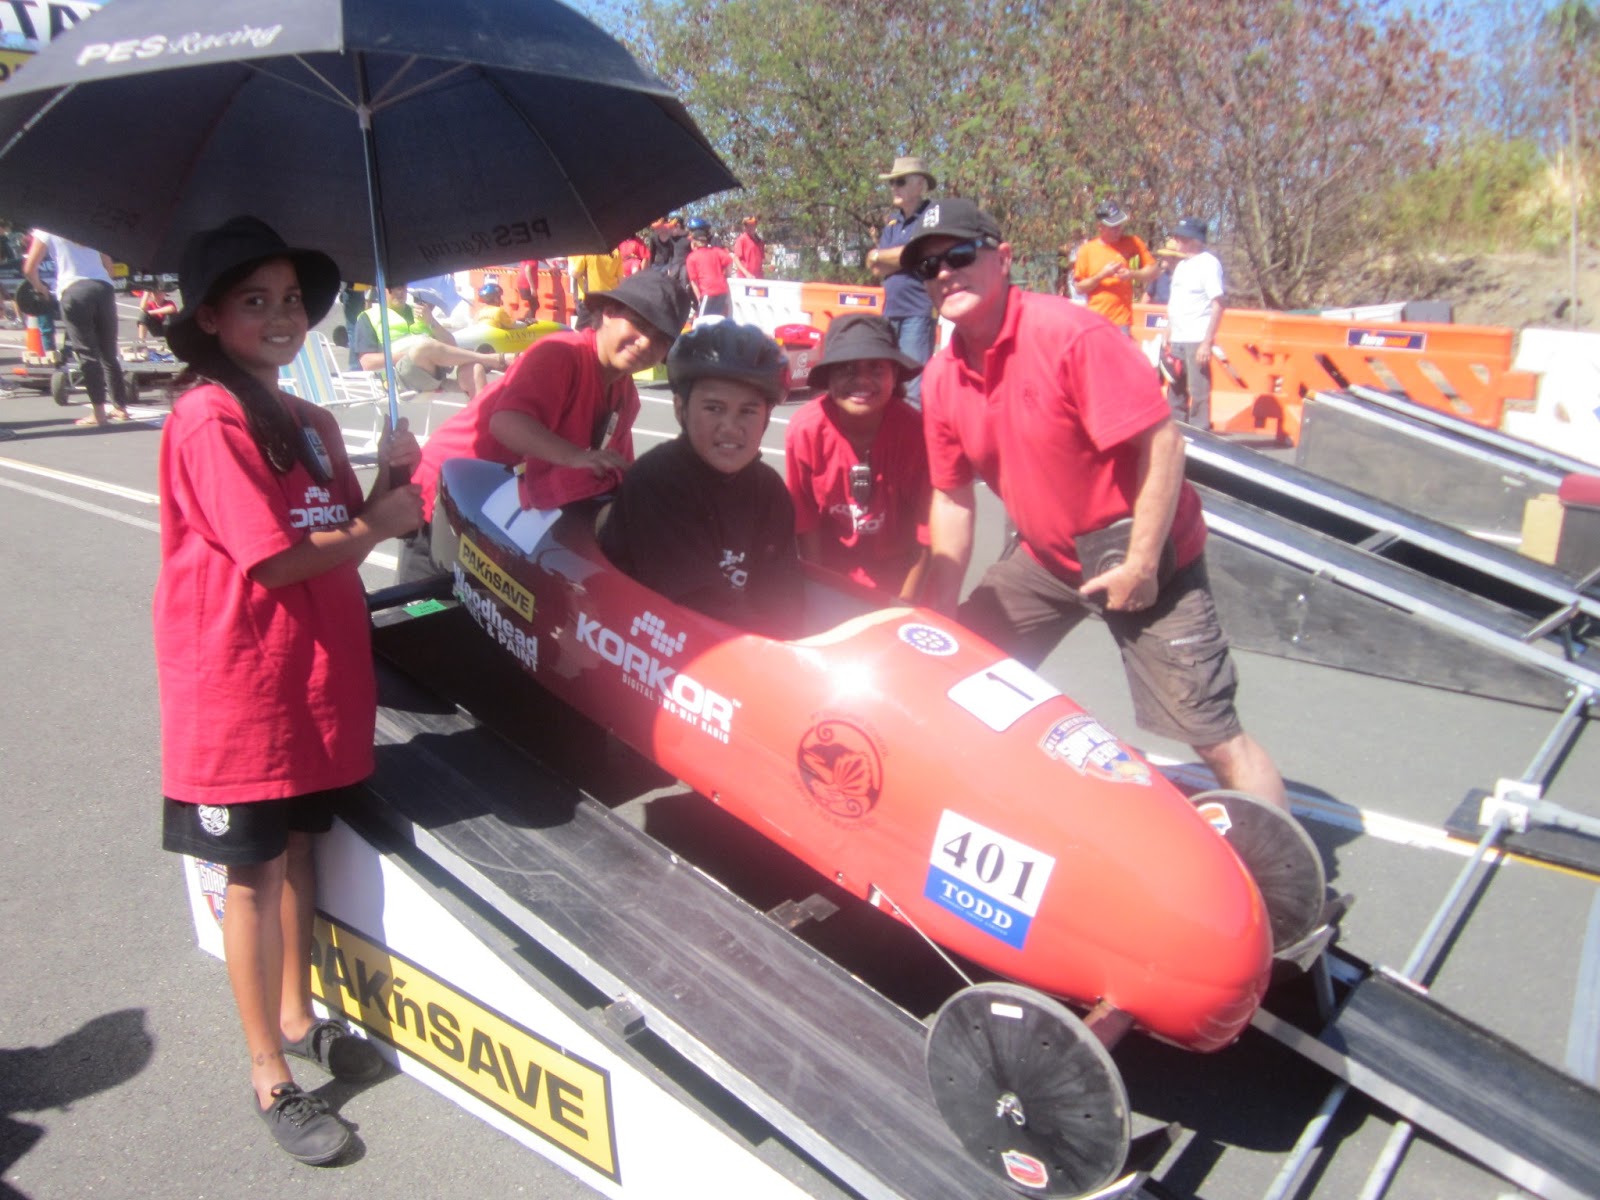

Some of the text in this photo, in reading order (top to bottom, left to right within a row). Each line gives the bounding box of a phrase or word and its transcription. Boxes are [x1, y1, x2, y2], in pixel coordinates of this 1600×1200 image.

[76, 35, 168, 66] PES
[453, 561, 538, 659] Woodhead
[497, 630, 538, 672] PAINT
[576, 611, 734, 733] KORKOR
[622, 672, 730, 745] DIGITAL TWO-WAY RADIO
[942, 831, 1035, 904] 401
[941, 879, 1014, 930] TODD
